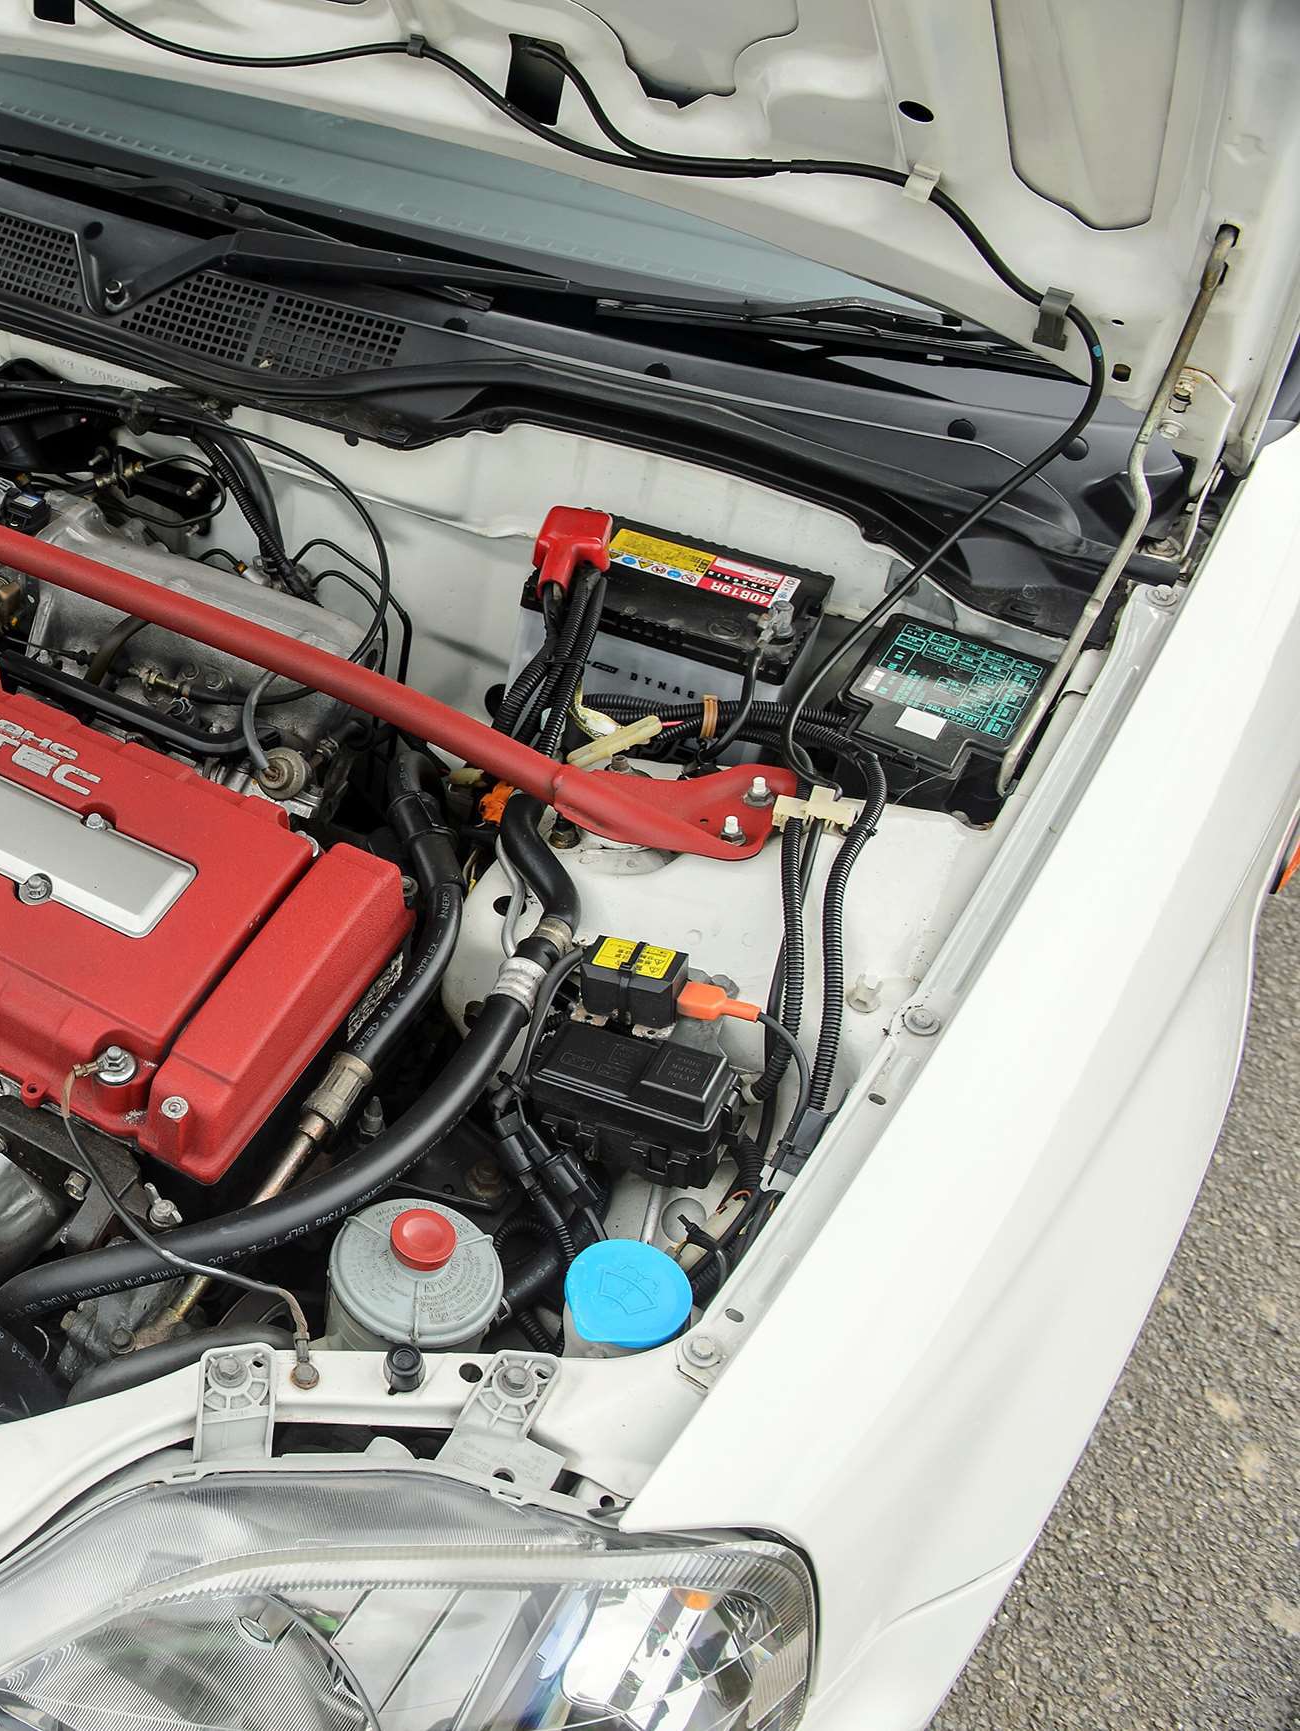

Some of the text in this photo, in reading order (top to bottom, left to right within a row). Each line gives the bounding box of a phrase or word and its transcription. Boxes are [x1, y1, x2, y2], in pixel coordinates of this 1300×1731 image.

[711, 581, 770, 604] 40B19R
[630, 672, 696, 699] DYNAG
[945, 707, 980, 723] BATTERY
[124, 1275, 146, 1287] JPN
